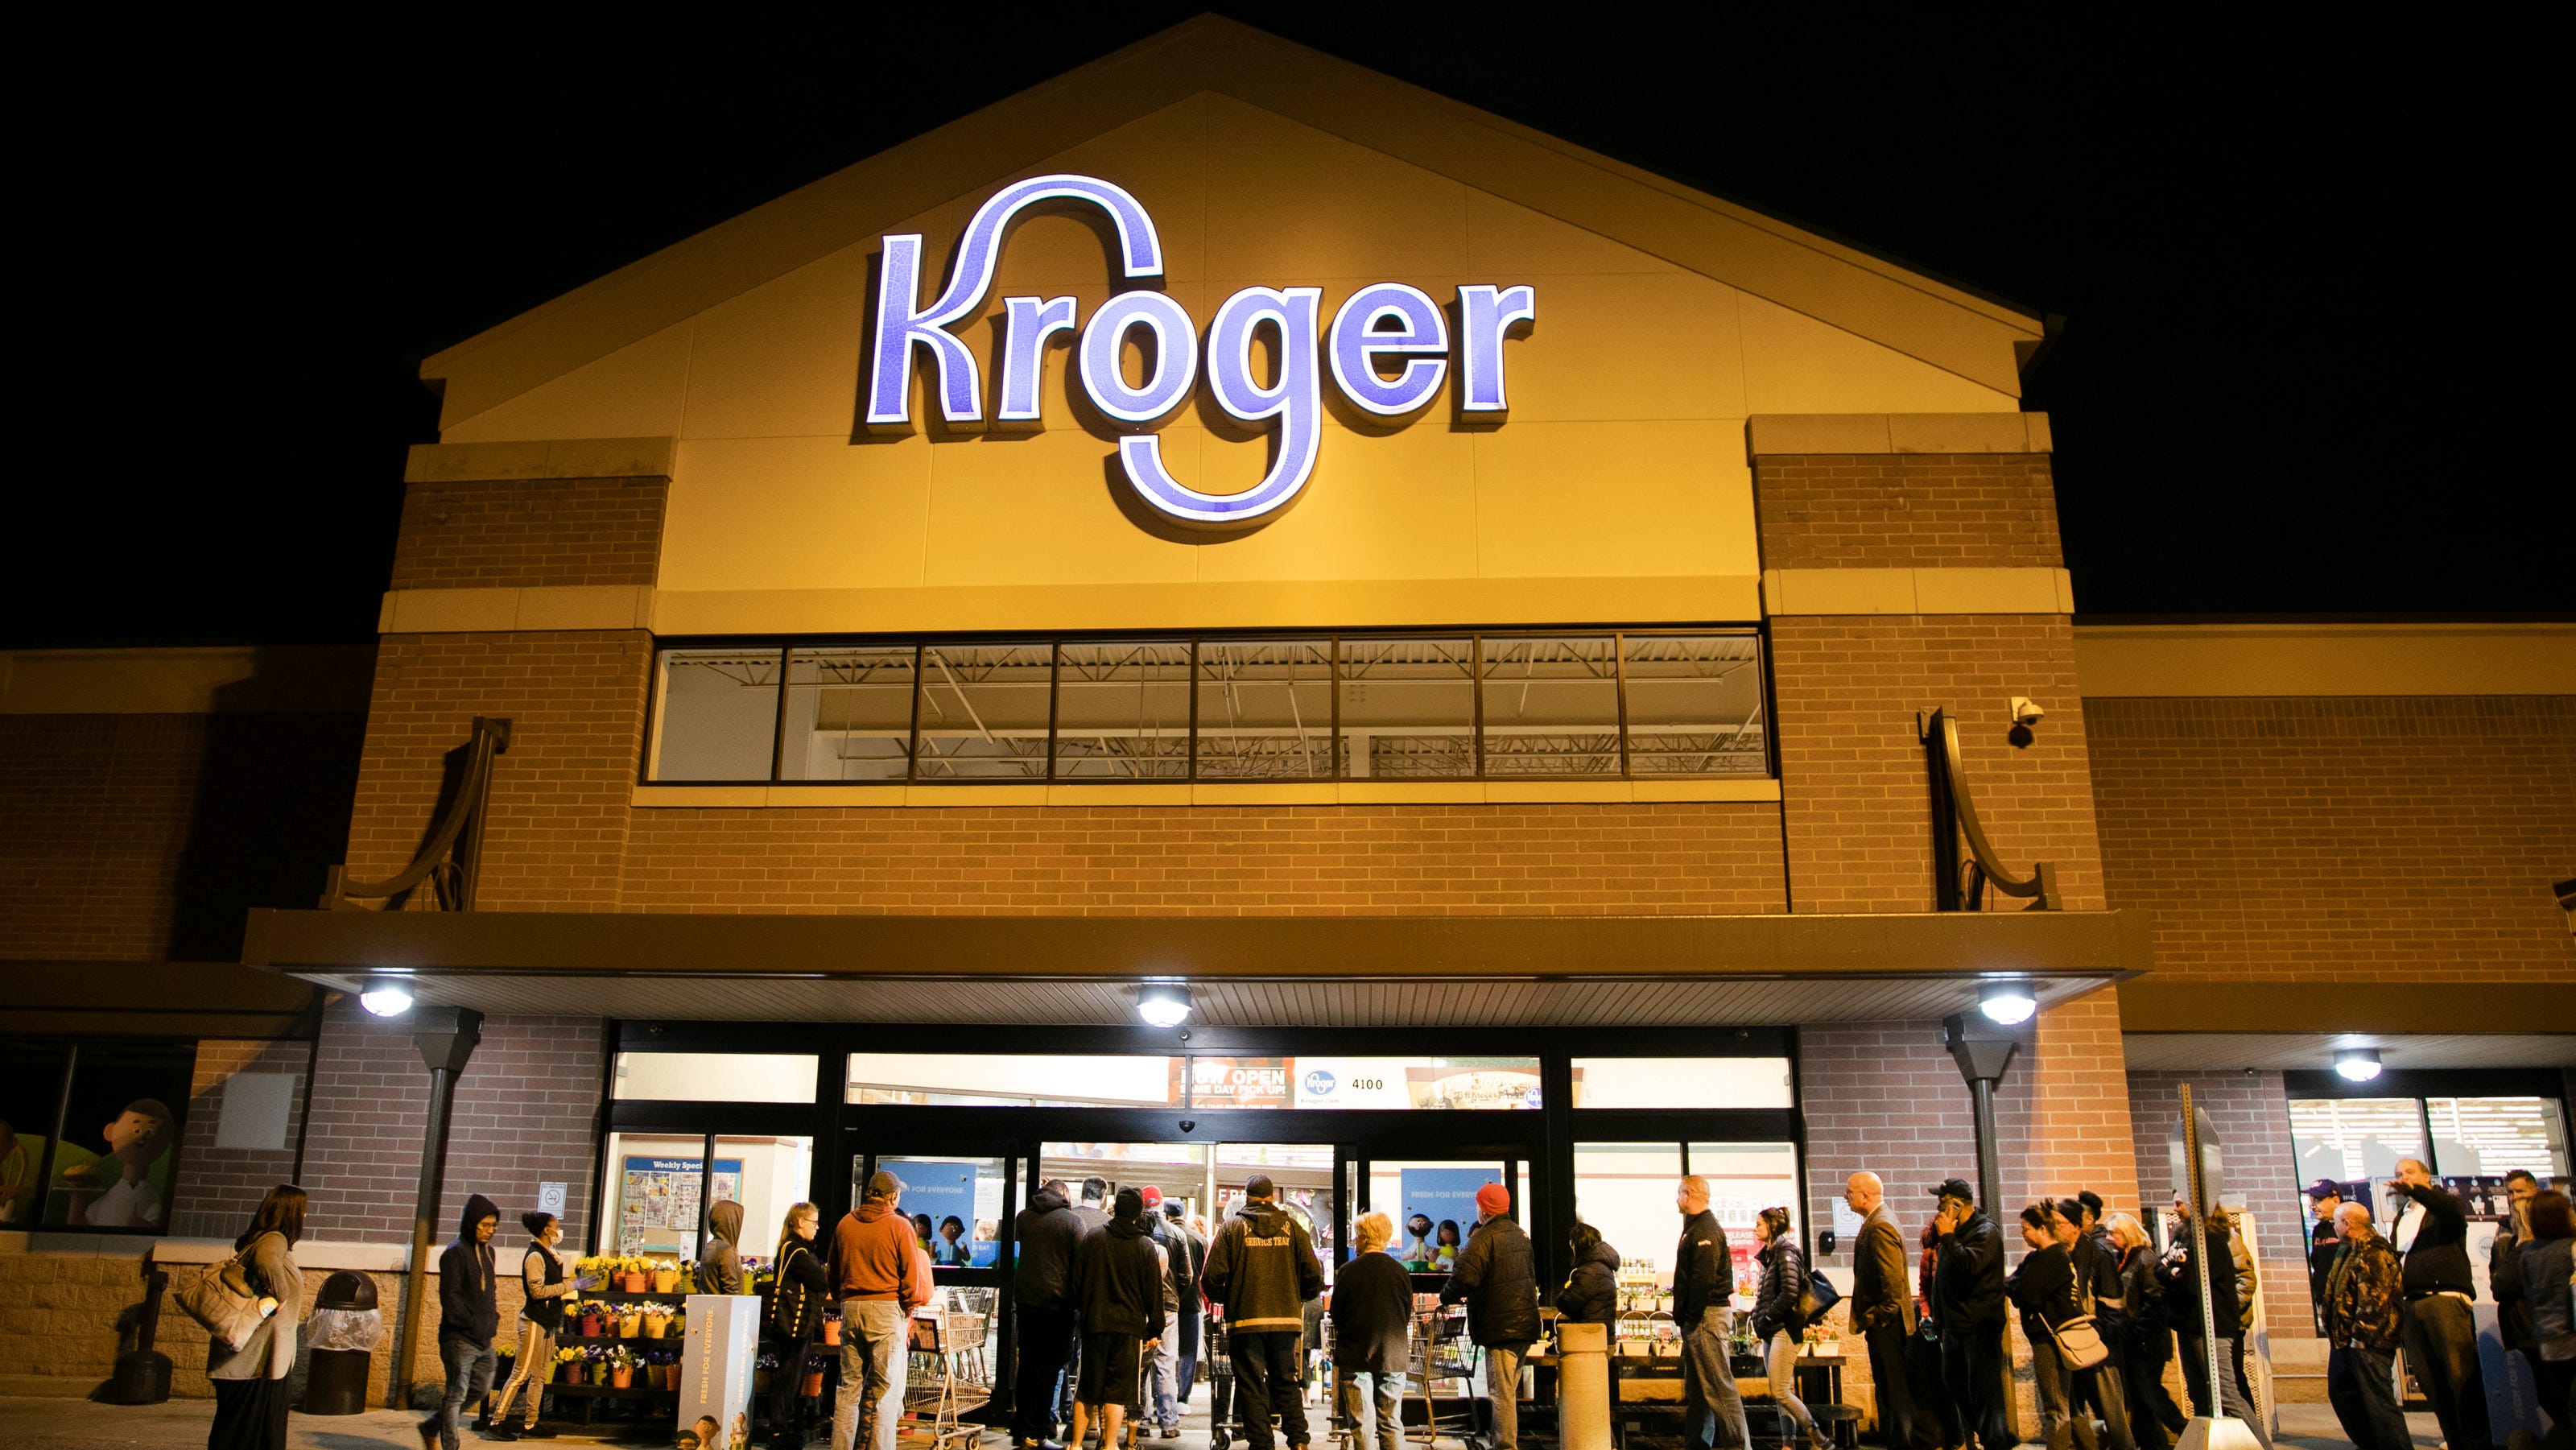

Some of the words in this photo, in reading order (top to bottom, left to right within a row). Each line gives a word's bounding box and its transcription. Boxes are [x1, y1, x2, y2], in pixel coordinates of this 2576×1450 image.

[865, 172, 1537, 526] Kroger
[1232, 1069, 1286, 1085] OPEN
[1305, 1072, 1335, 1094] Kroger
[1352, 1079, 1383, 1089] 4100
[1214, 1084, 1236, 1094] DAY
[1237, 1084, 1265, 1094] PICK
[1267, 1085, 1286, 1094] UP!
[1527, 1089, 1542, 1106] Kro
[653, 1161, 681, 1171] Weekly
[682, 1162, 703, 1170] Speci
[1245, 1237, 1272, 1246] SERVICE
[1273, 1236, 1290, 1246] TEAM
[702, 1357, 710, 1375] FOR
[700, 1378, 709, 1404] FRESH
